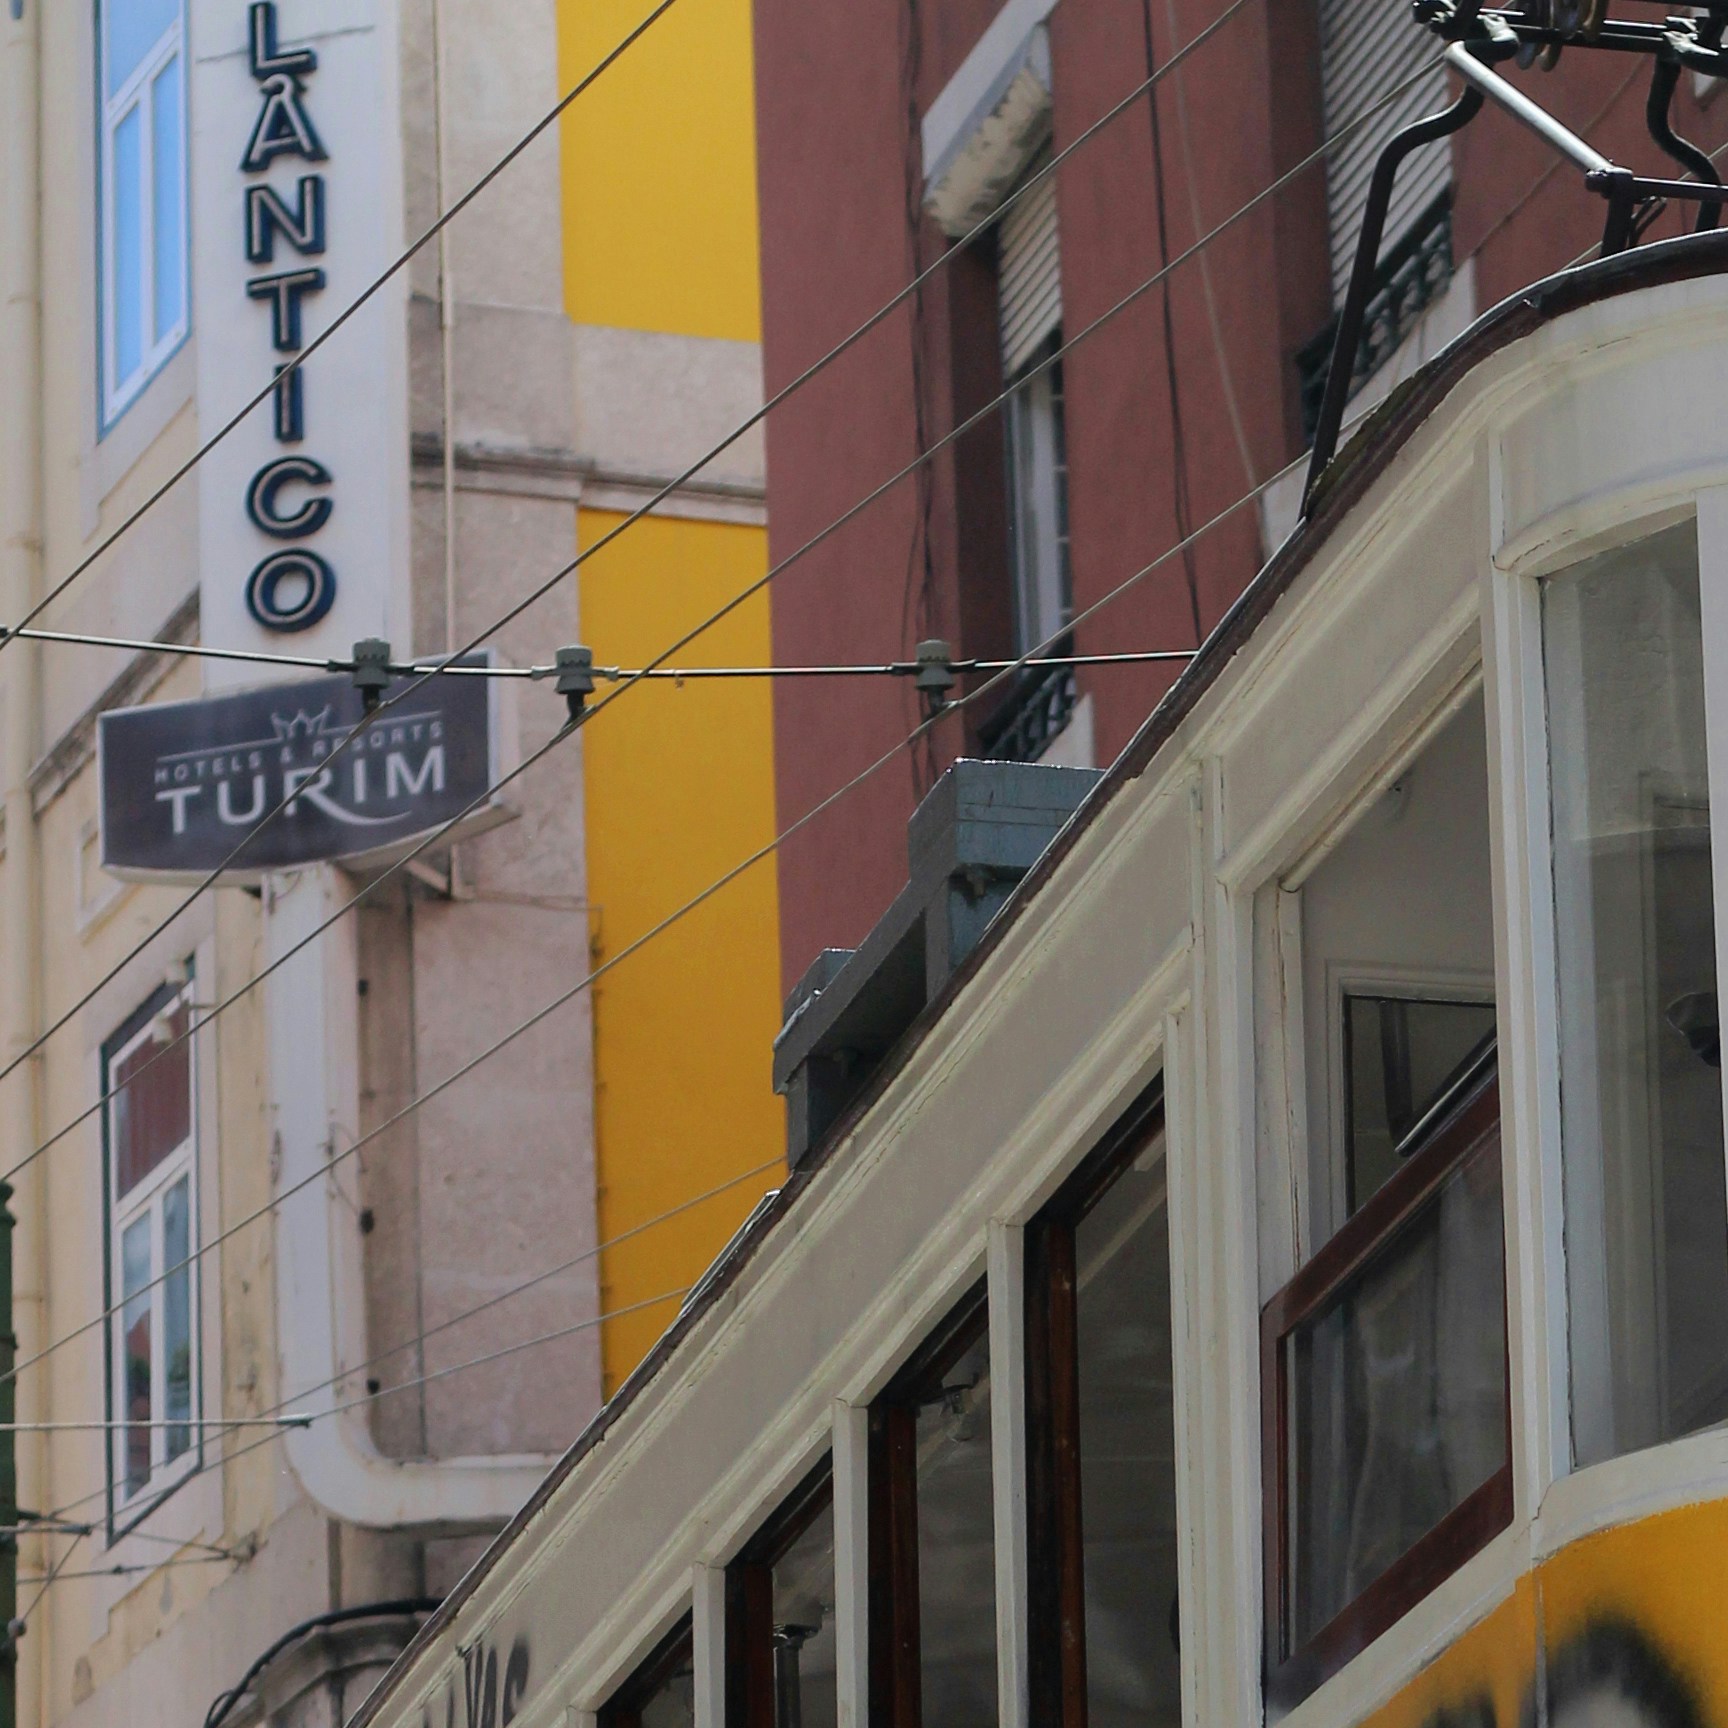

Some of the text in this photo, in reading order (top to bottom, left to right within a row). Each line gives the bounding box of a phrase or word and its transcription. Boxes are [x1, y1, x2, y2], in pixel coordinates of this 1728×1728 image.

[154, 750, 262, 784] HOTELS
[312, 721, 443, 757] RESORTS
[154, 745, 446, 835] TURIM
